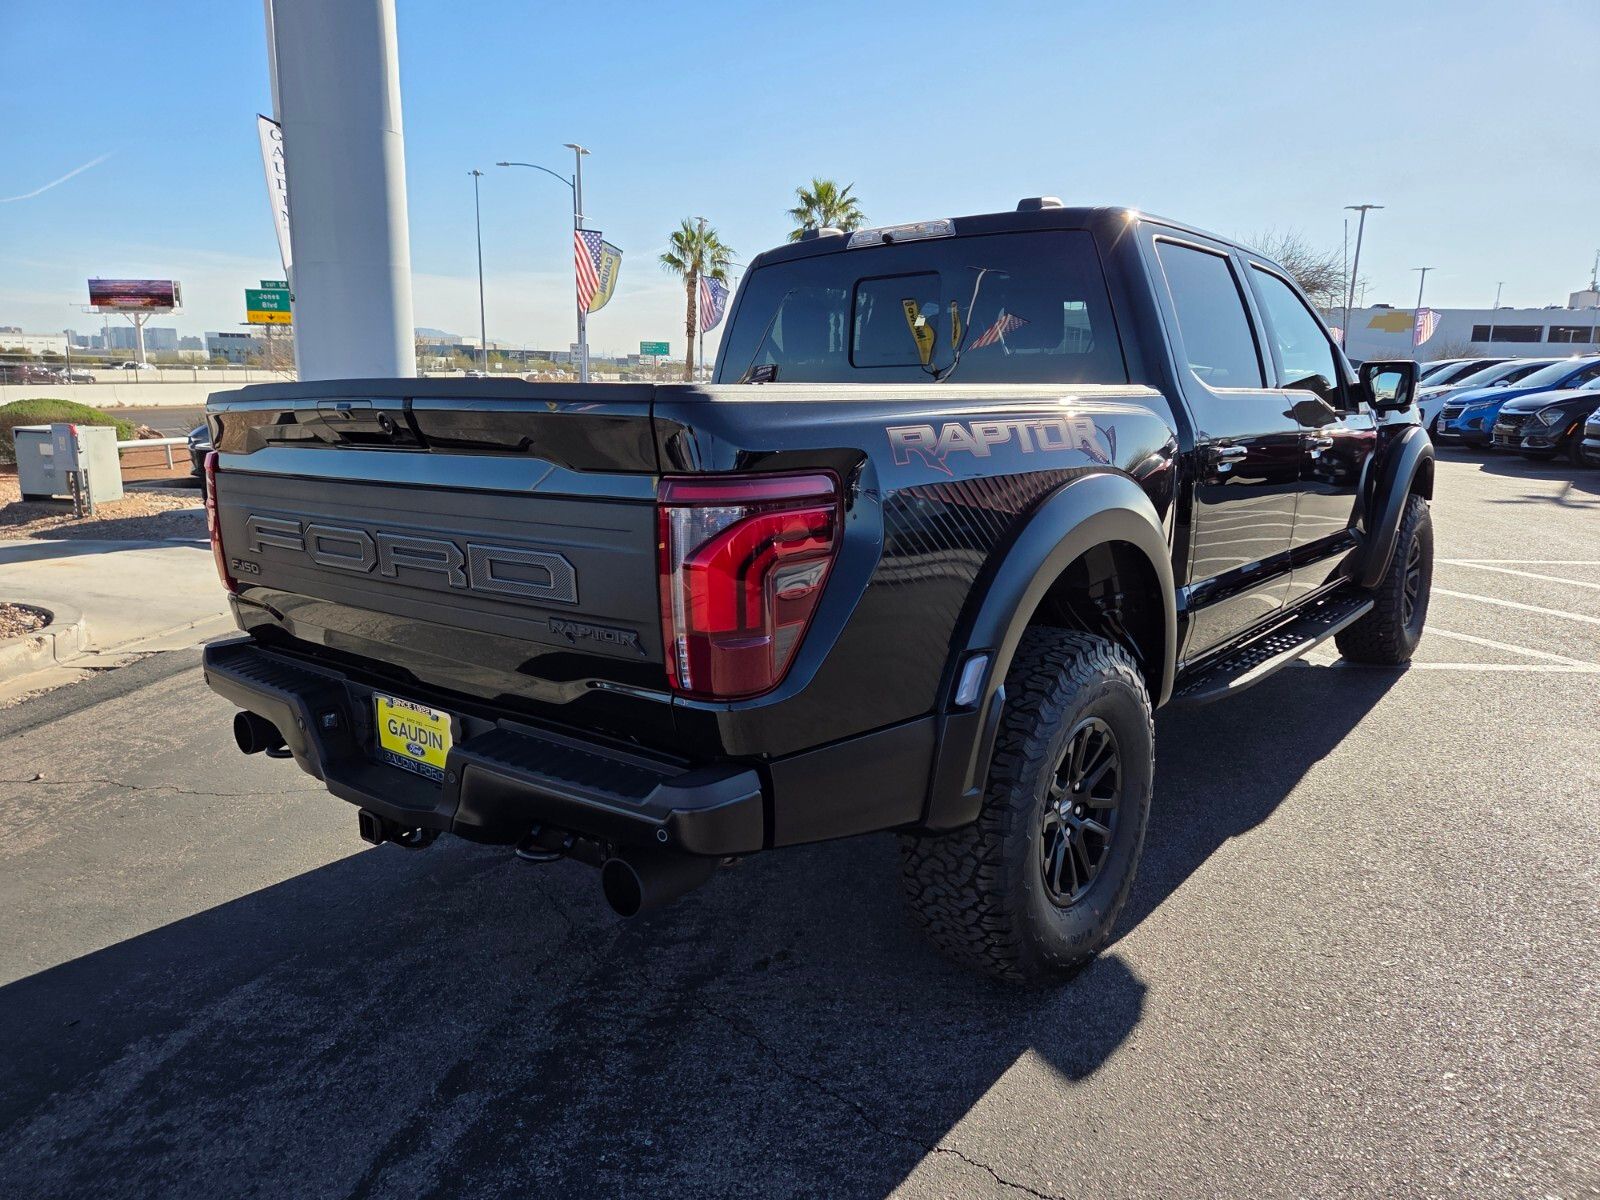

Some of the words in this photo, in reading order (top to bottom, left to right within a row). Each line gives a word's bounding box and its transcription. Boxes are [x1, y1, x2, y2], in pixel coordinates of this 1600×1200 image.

[885, 416, 1111, 477] RAPTOR
[245, 513, 580, 605] FORD
[547, 616, 648, 656] RAPTOR
[387, 718, 443, 751] GAUDIN
[408, 743, 424, 757] Ford
[384, 752, 418, 771] GAUDIN
[420, 765, 445, 781] FORD
